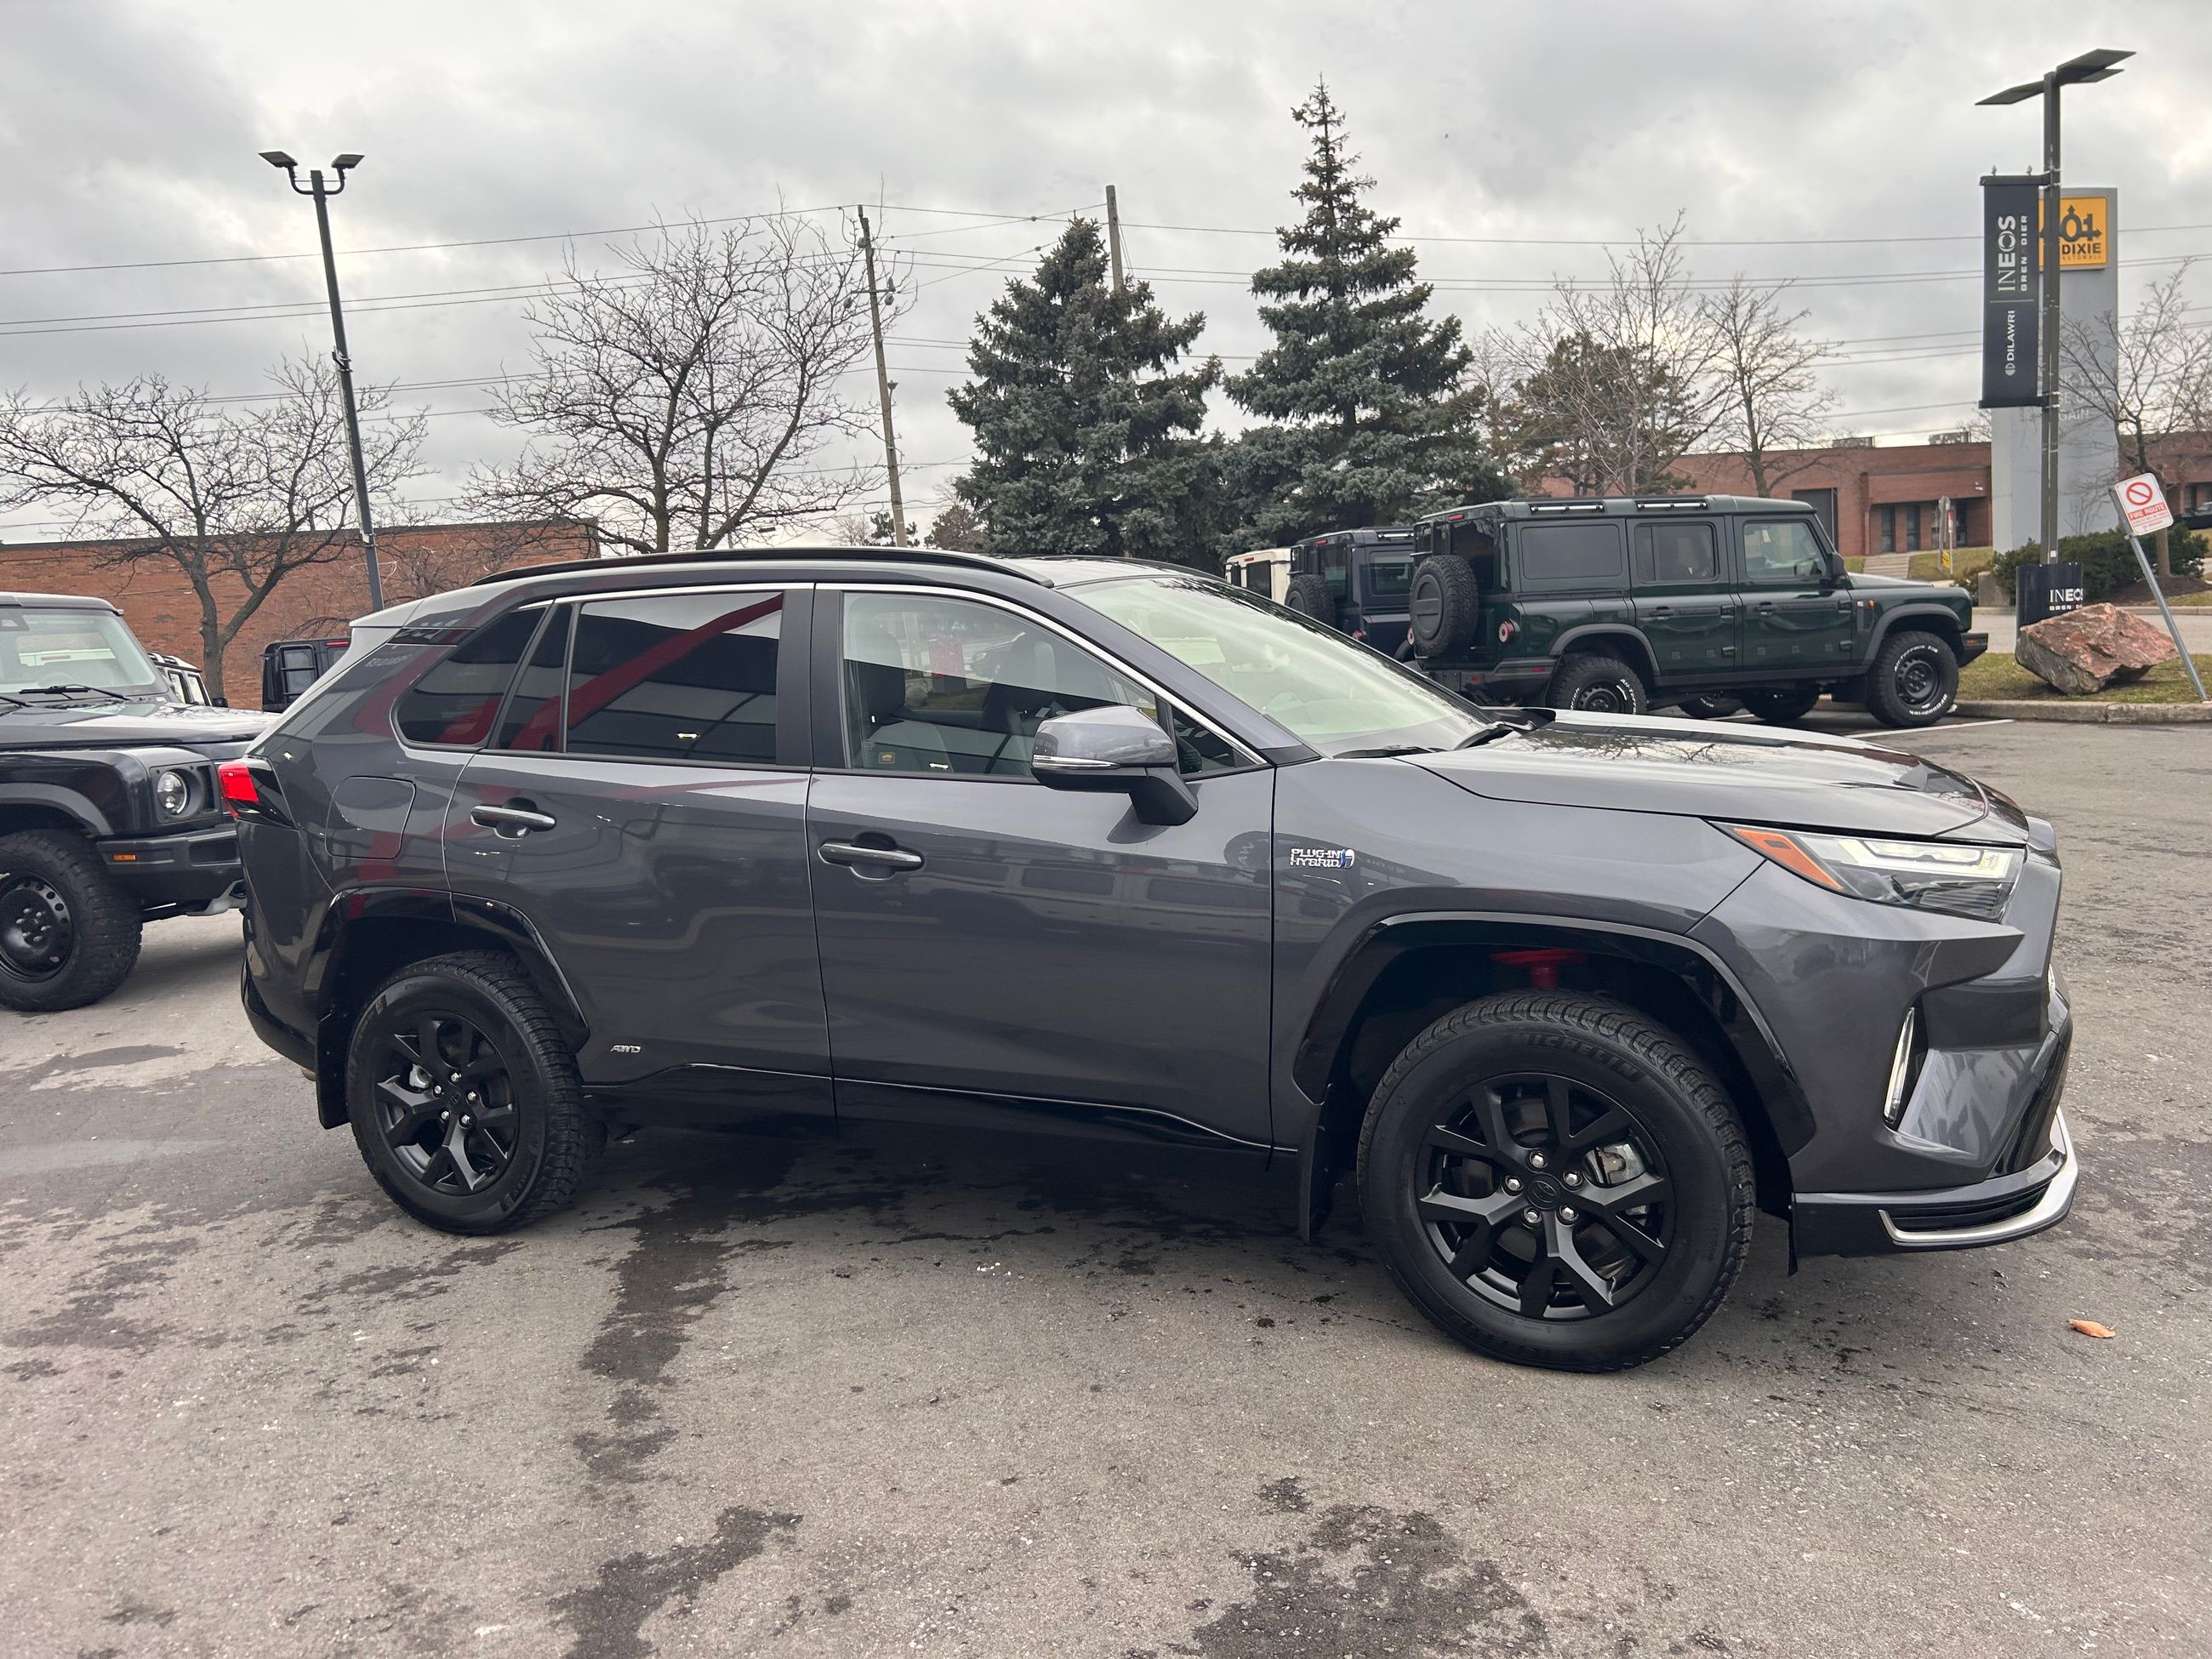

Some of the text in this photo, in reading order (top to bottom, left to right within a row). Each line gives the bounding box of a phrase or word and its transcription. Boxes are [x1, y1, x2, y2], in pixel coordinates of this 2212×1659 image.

[1998, 215, 2016, 292] INEOS
[2020, 215, 2028, 292] GRENDIER
[2061, 242, 2101, 254] DIXIE
[2006, 310, 2015, 362] DILAWRI
[2059, 409, 2089, 421] GAIN
[2129, 511, 2145, 520] FIRE
[2144, 503, 2166, 516] ROUTE
[1290, 856, 1342, 868] HYBRID
[1291, 848, 1342, 859] PLUG-IN
[1509, 1034, 1643, 1078] MICHELIN
